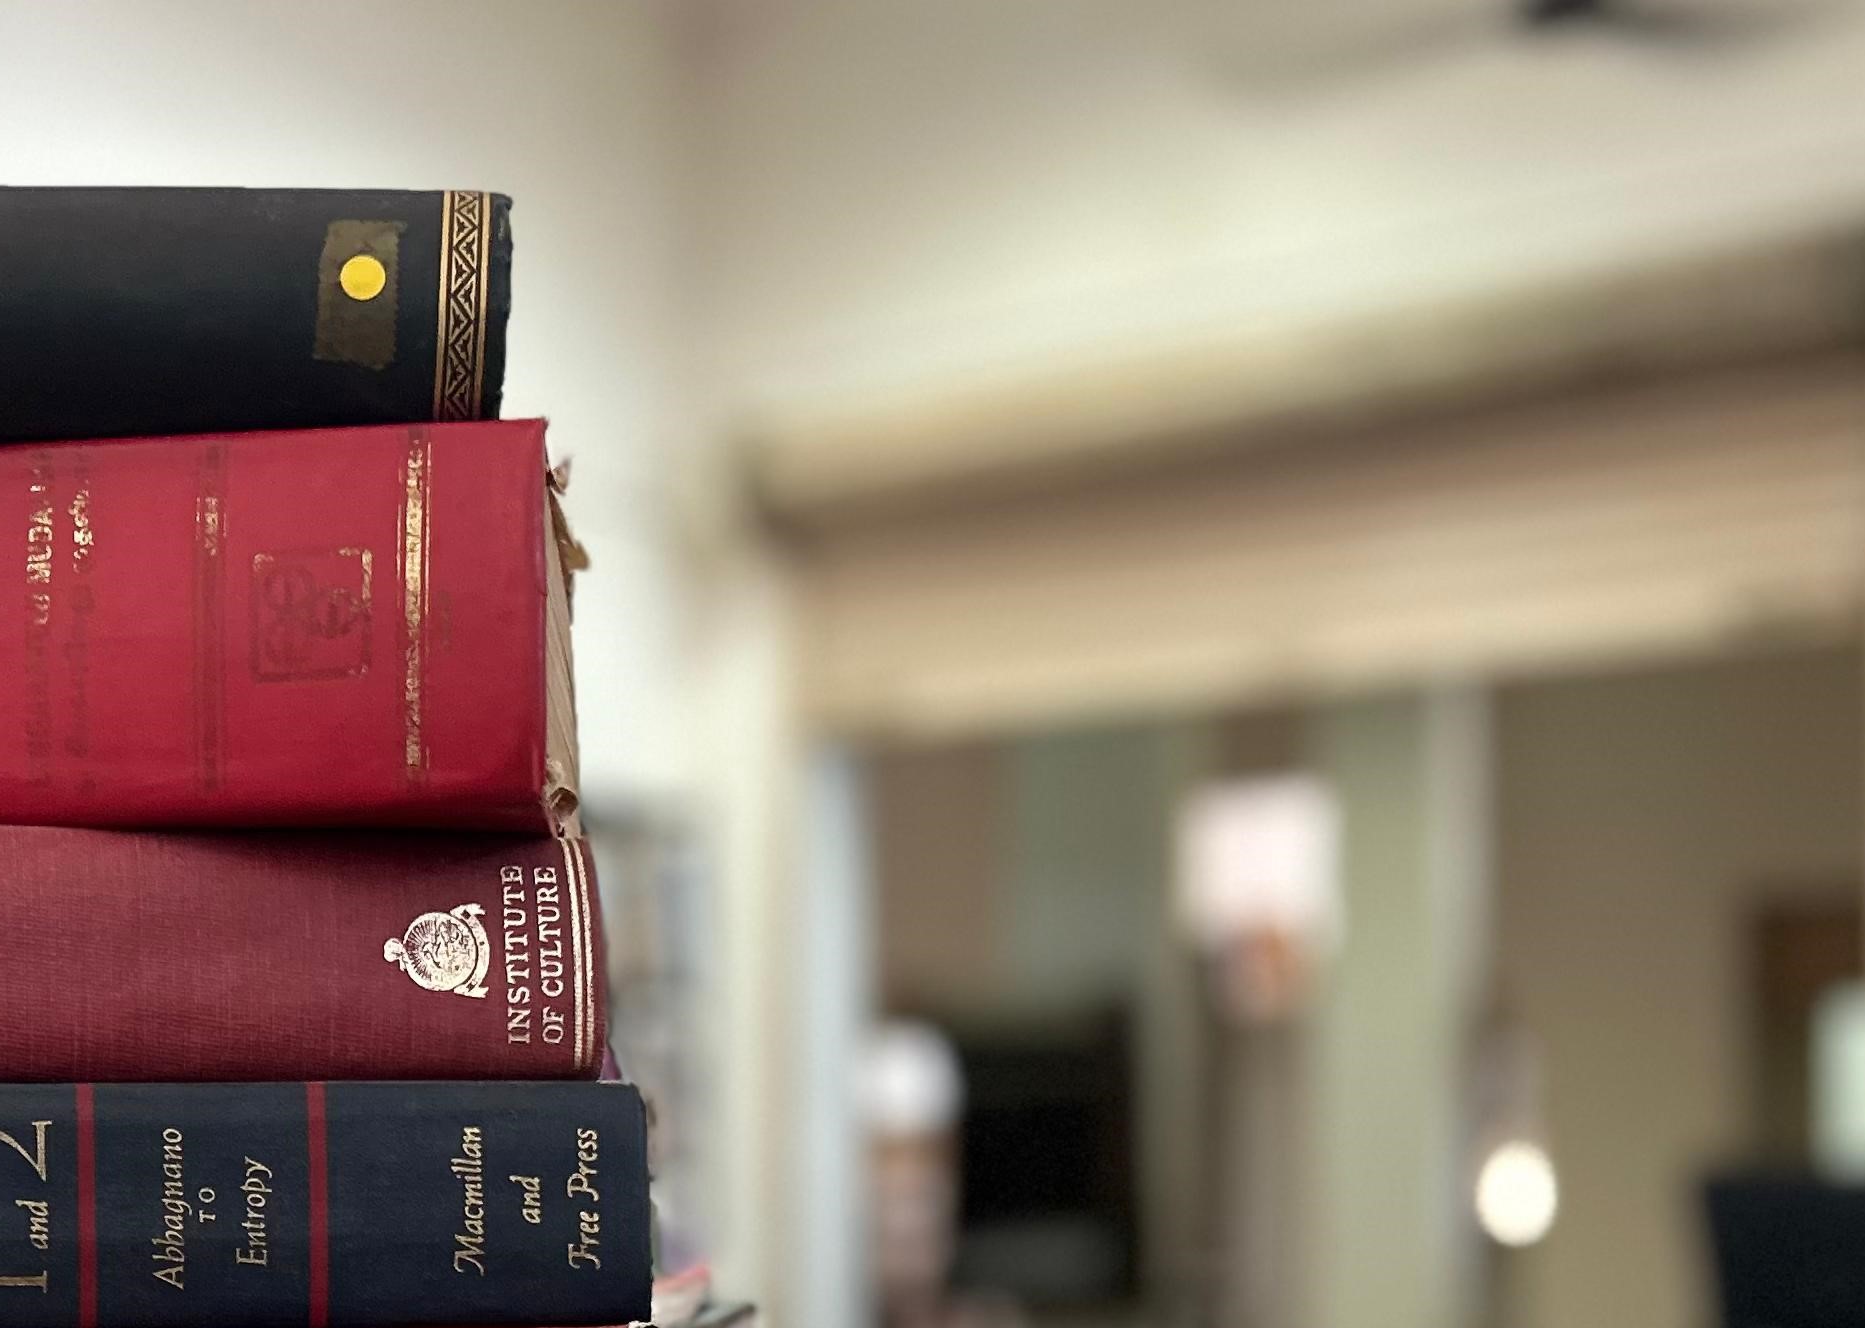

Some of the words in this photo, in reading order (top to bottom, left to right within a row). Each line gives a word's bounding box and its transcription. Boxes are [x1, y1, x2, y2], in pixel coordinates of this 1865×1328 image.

[499, 865, 532, 1045] INSTITUTE
[533, 866, 565, 998] CULTURE
[542, 1005, 565, 1045] OF
[151, 1127, 194, 1292] Abbagnano
[450, 1125, 486, 1278] Macmillan
[508, 1174, 542, 1225] and
[566, 1126, 600, 1202] Press
[14, 1199, 50, 1250] and
[235, 1155, 273, 1268] Entropy
[566, 1209, 602, 1270] Free
